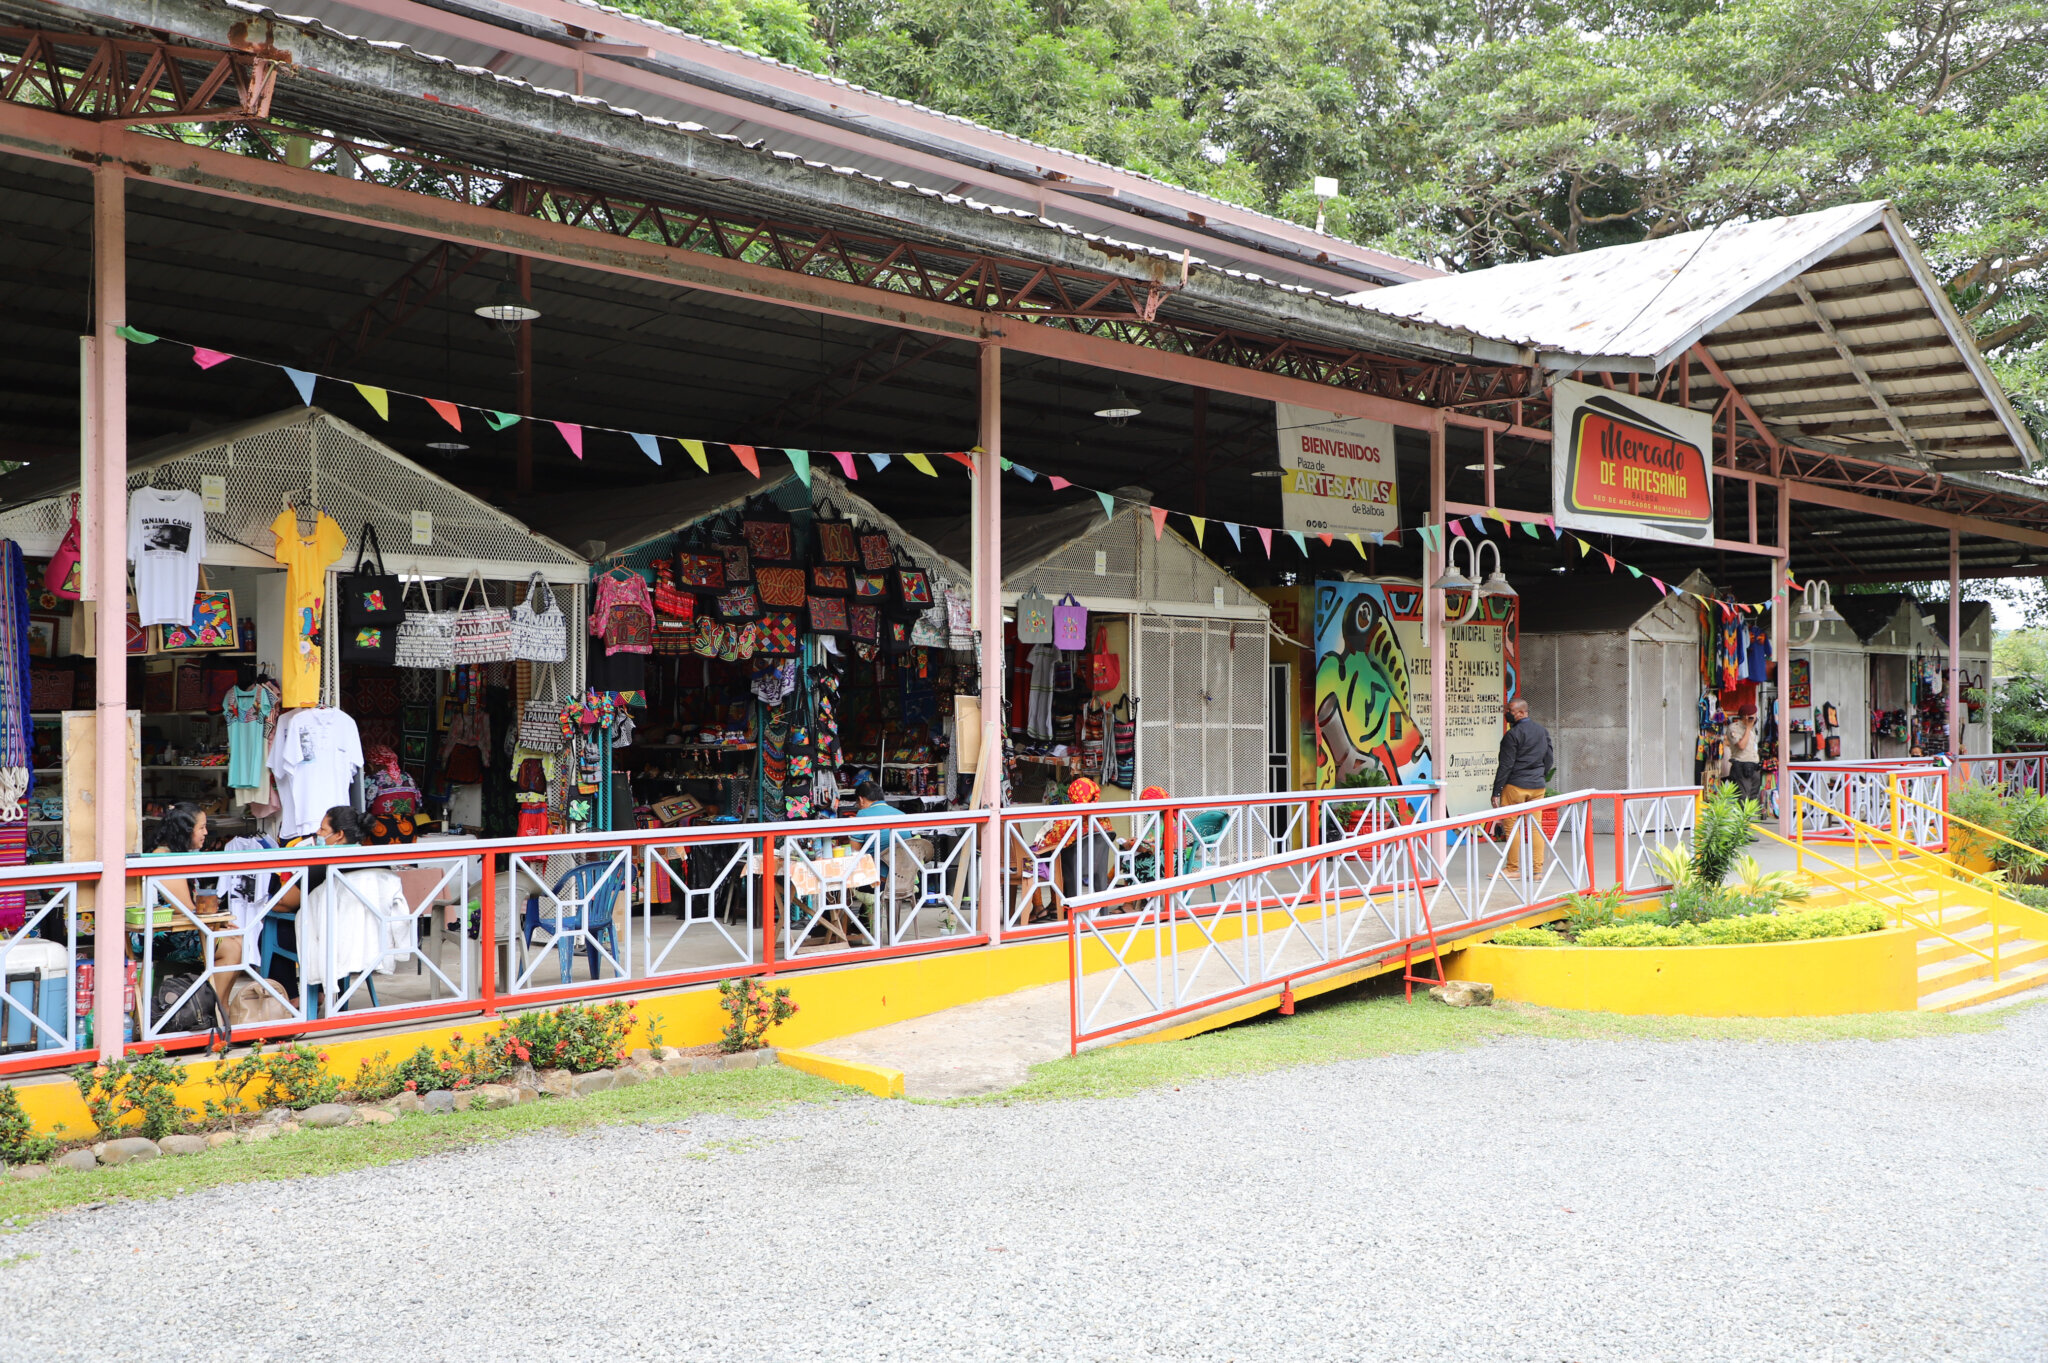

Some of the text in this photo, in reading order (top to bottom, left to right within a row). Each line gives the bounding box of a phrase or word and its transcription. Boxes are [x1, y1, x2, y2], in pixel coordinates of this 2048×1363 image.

[1301, 436, 1380, 463] BIENVENIDOS
[1601, 422, 1684, 471] Mercado
[1298, 457, 1325, 471] Plaza de
[1295, 471, 1390, 503] ARTESANIAS
[1601, 461, 1687, 498] DE ARTESANÍA
[1631, 492, 1658, 502] BALBOA
[1352, 503, 1384, 516] de Balboa
[1593, 494, 1606, 502] RED
[1619, 499, 1651, 510] MERCADOS
[1653, 504, 1692, 516] MUNICIPALES
[142, 517, 169, 525] PANAMA
[172, 519, 192, 529] CANAL
[453, 621, 501, 638] PANAMA
[1452, 626, 1486, 641] MUNICIPAL
[1450, 643, 1458, 658] DE
[528, 712, 559, 725] PANAMA
